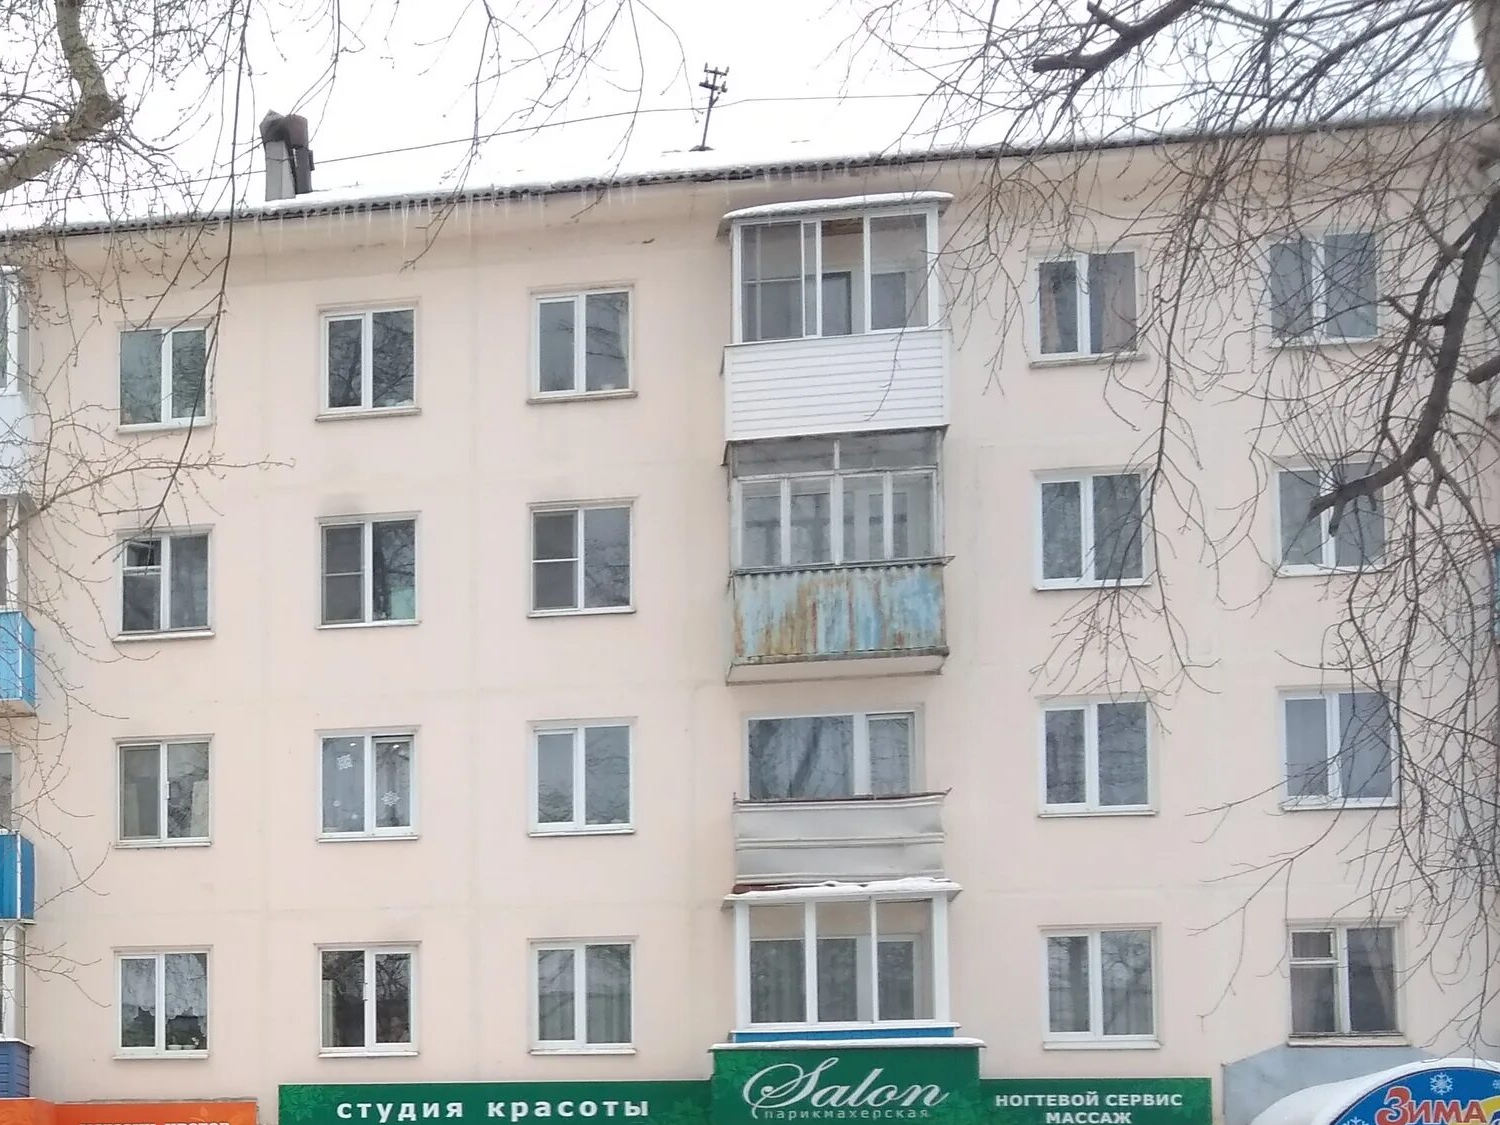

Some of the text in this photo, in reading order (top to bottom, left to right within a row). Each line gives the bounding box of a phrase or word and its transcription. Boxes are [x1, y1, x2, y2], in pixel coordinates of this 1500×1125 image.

[743, 1057, 950, 1119] Salon
[995, 1091, 1183, 1107] НОГТЕВОЙ СЕРВИС
[337, 1100, 649, 1123] студия красоты
[764, 1108, 931, 1121] парикмахерская
[1045, 1112, 1132, 1124] МАССАЖ
